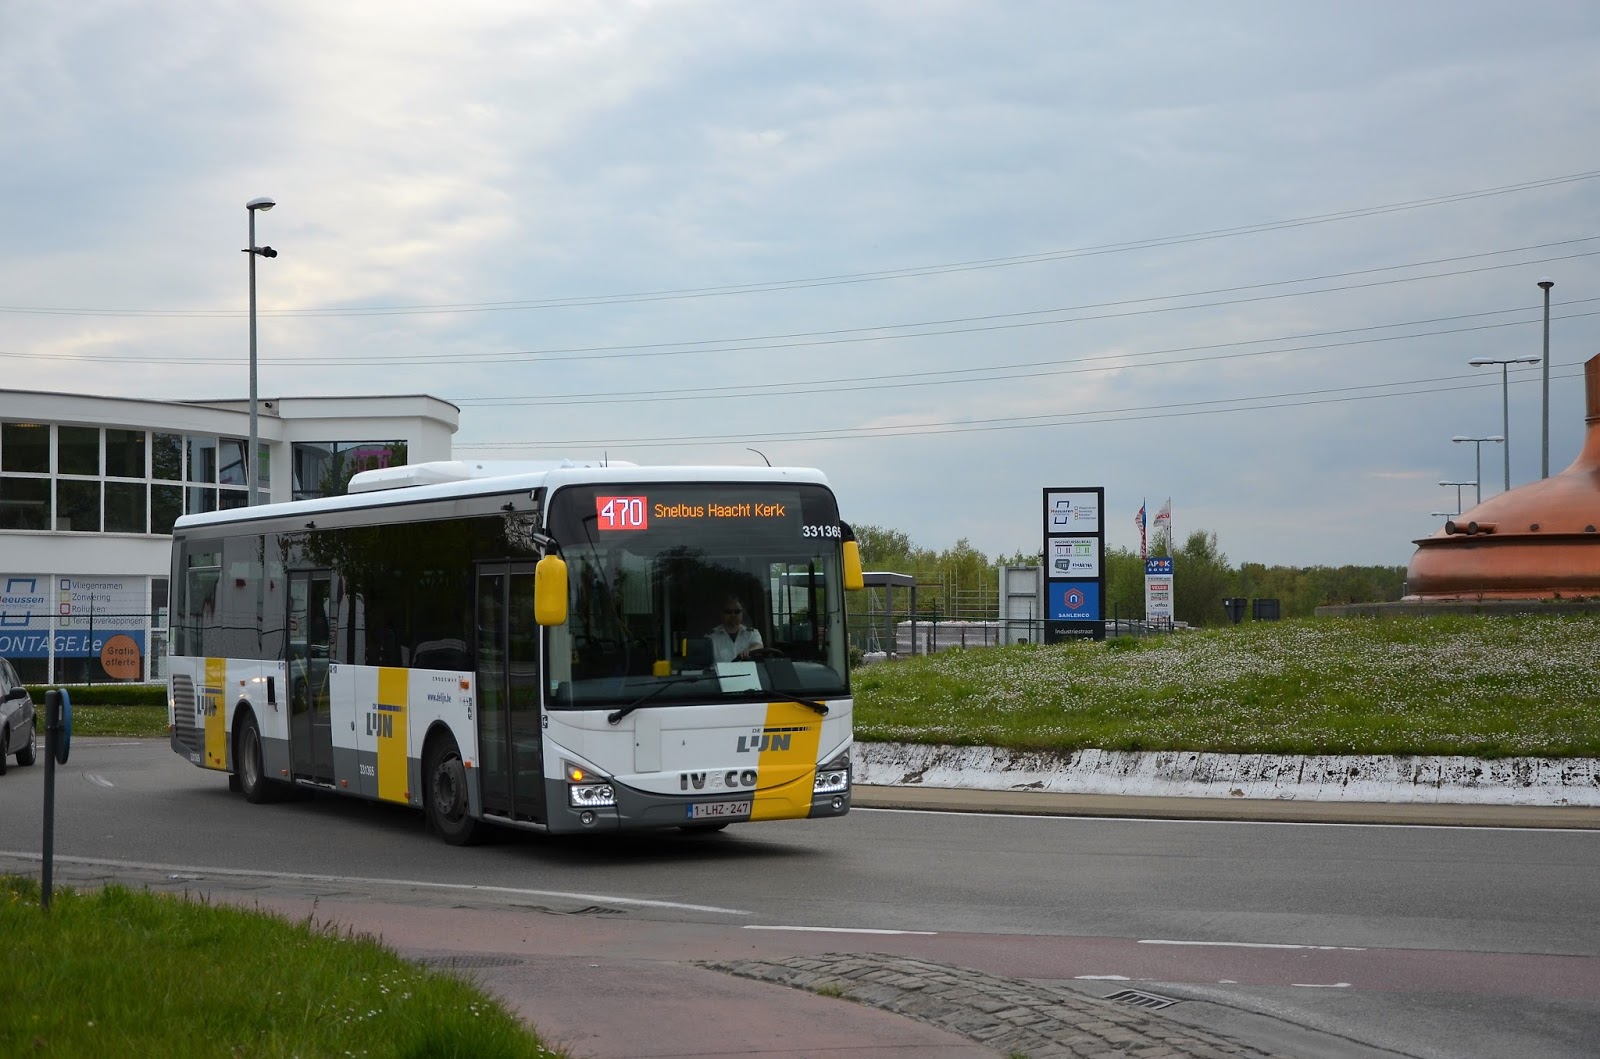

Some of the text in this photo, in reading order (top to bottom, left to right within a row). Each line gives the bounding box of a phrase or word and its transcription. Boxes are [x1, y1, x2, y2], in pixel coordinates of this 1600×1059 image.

[600, 498, 785, 526] 470 Snelbus Haacht Kerk
[802, 525, 841, 538] 331365
[72, 581, 123, 591] Vliegenramen
[0, 596, 44, 604] eeussen
[72, 593, 111, 602] Zonwering
[72, 604, 106, 613] Rolluken
[73, 616, 143, 626] Terraoverkappingen
[107, 646, 134, 655] Gratis
[105, 658, 136, 667] offerte
[366, 712, 393, 739] LIJN
[736, 734, 791, 753] LIJN
[359, 764, 375, 777] 331365
[694, 803, 749, 816] 1-LHZ-247
